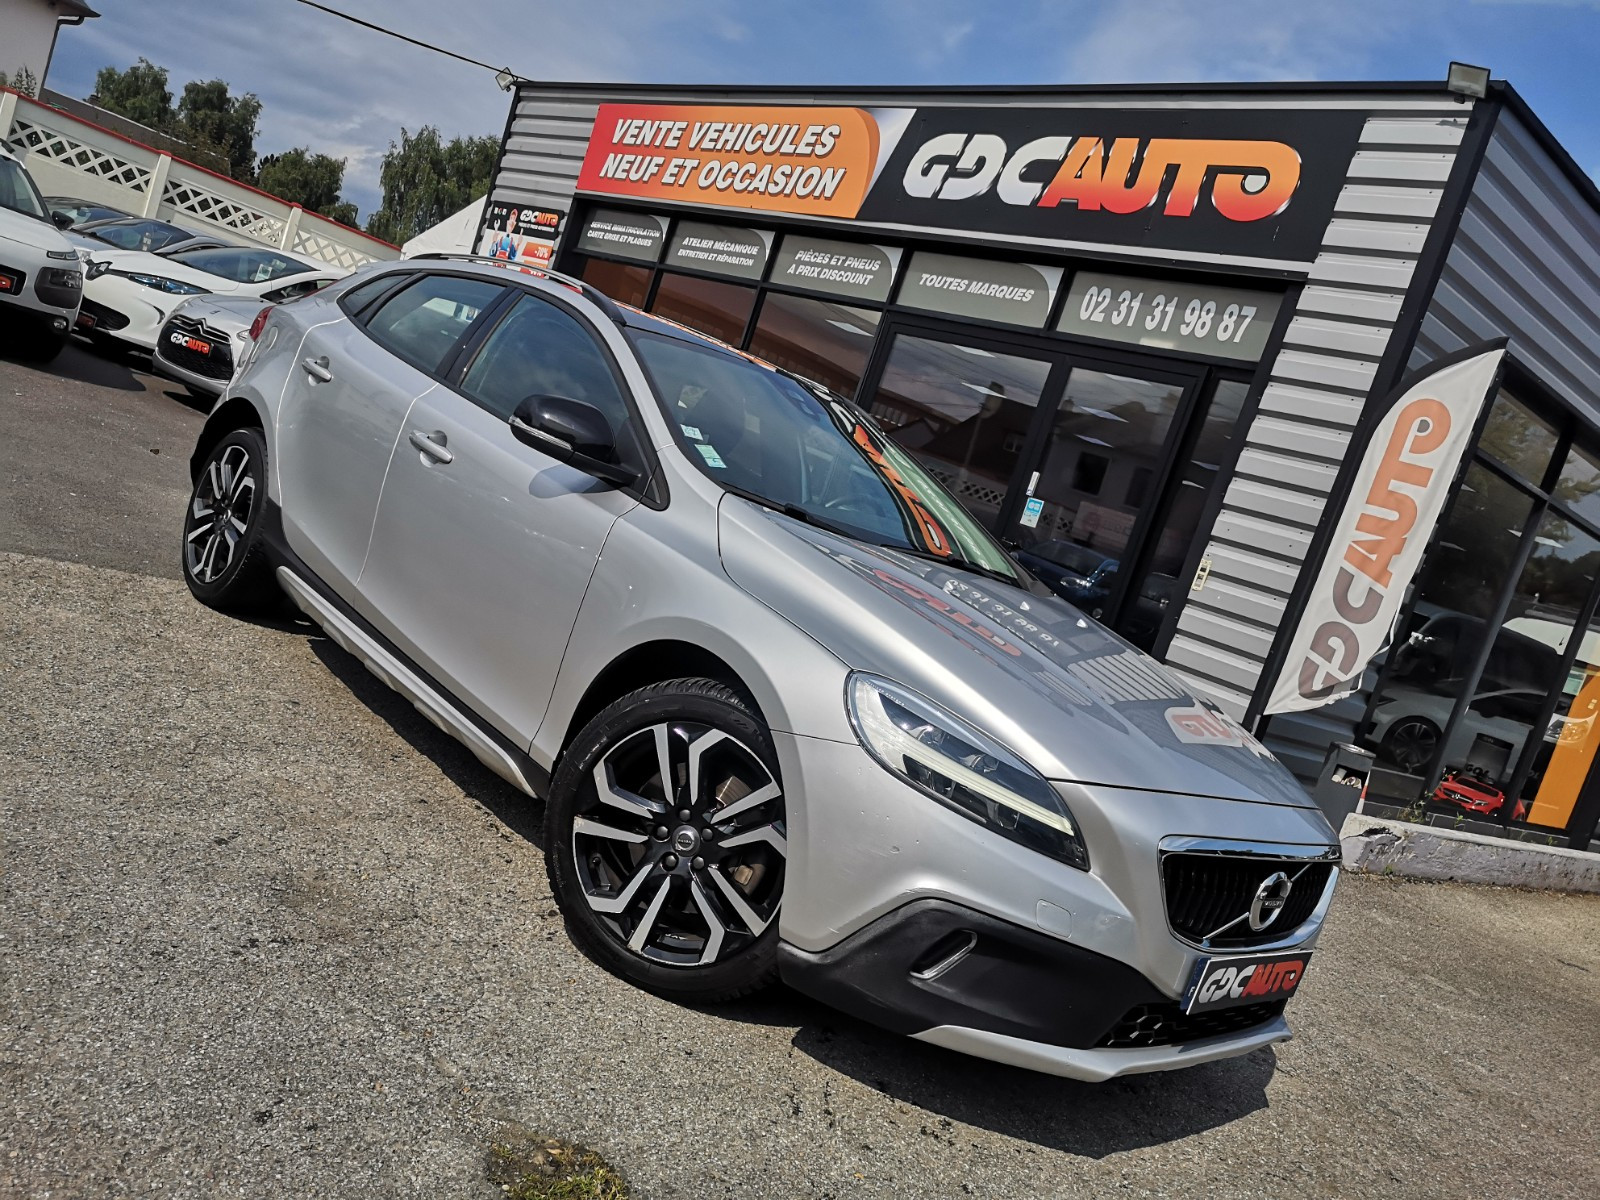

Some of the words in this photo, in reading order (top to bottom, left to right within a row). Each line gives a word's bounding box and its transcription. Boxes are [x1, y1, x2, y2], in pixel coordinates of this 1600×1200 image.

[611, 118, 688, 148] VENTE
[688, 121, 841, 157] VEHICULES
[599, 153, 665, 180] NEUF
[661, 158, 699, 186] ET
[697, 160, 847, 200] OCCASION
[587, 230, 605, 240] CARTE
[603, 232, 620, 242] GRISE
[619, 234, 628, 243] ET
[626, 236, 653, 247] PLAQUES
[590, 221, 612, 231] SERVICE
[611, 224, 661, 238] IMMATRICULATION
[682, 237, 714, 249] ATELIER
[712, 240, 760, 255] MÉCANIQUE
[677, 248, 709, 260] ENTRETIEN
[707, 253, 718, 261] ET
[716, 253, 755, 266] RÉPARATION
[794, 249, 831, 265] PIÈCES
[830, 256, 845, 266] ET
[844, 257, 881, 271] PNEUS
[796, 265, 821, 278] PRIX
[820, 268, 874, 286] DISCOUNT
[918, 273, 969, 292] TOUTES
[966, 281, 1035, 302] MARQUES
[1079, 286, 1110, 323] 02
[1111, 290, 1144, 327] 31
[1144, 294, 1179, 332] 31
[1179, 298, 1217, 338] 98
[1216, 303, 1257, 343] 87
